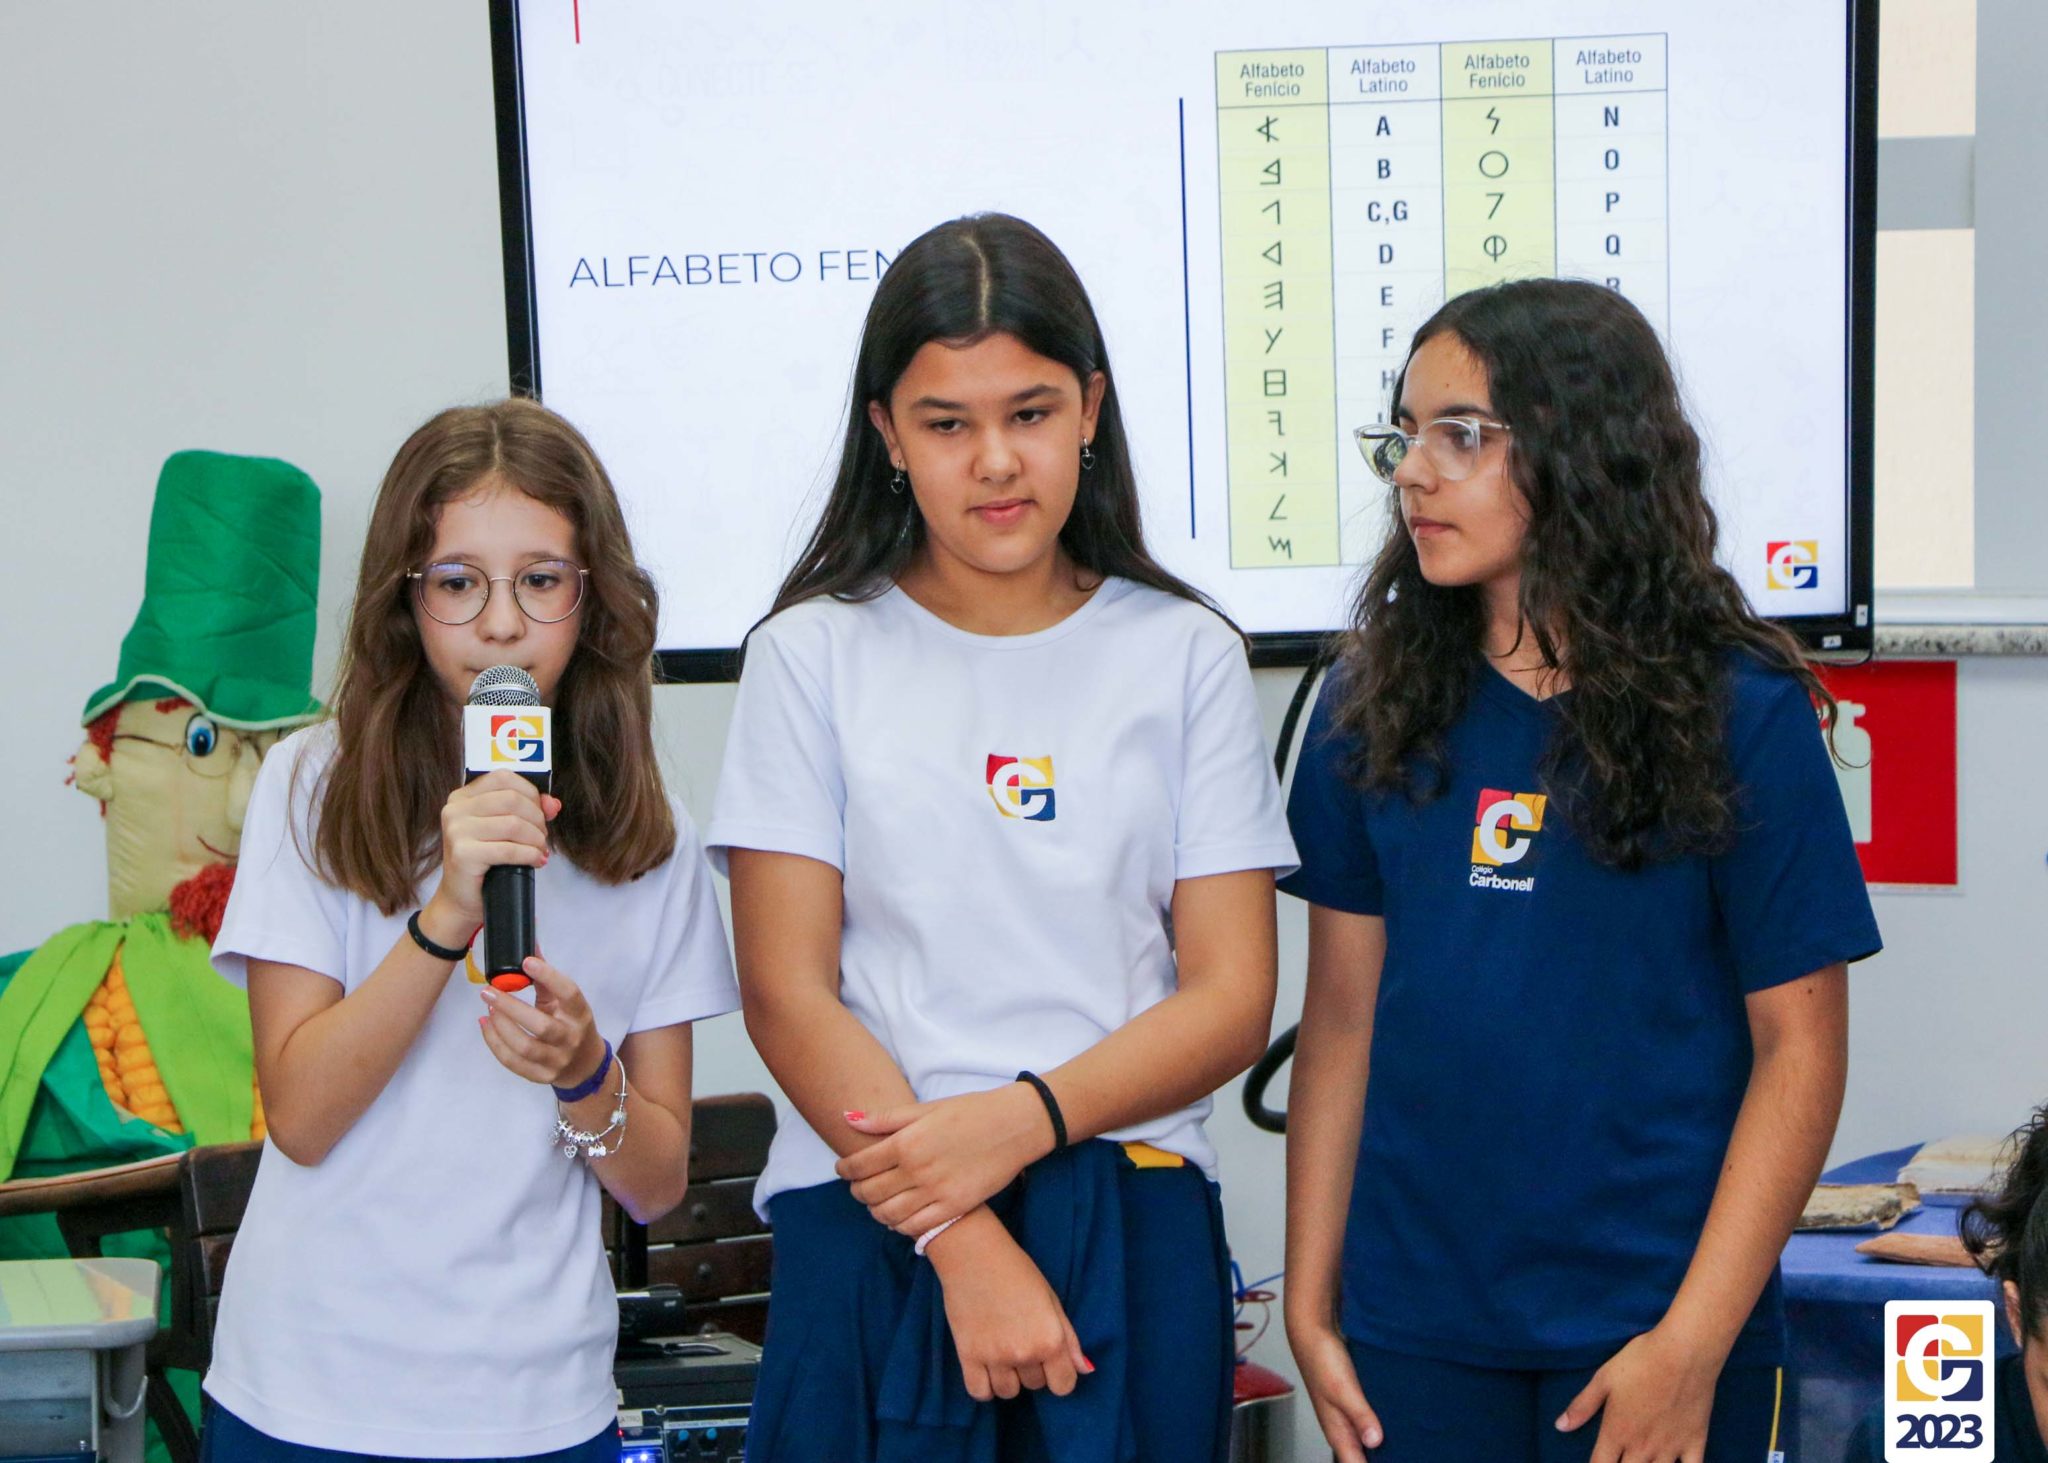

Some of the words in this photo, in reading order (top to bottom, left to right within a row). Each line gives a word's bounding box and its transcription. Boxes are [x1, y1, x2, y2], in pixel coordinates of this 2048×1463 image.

[1351, 58, 1416, 75] Alfabeto
[1464, 54, 1530, 70] Alfabeto
[1576, 49, 1642, 66] Alfabeto
[1240, 63, 1305, 79] Alfabeto
[1584, 69, 1634, 85] Latino
[1359, 78, 1408, 94] Latino
[1375, 115, 1391, 137] A
[1604, 106, 1619, 128] N
[1377, 158, 1391, 180] B
[1604, 148, 1620, 170] O
[1367, 200, 1408, 224] C,G
[1605, 192, 1620, 213] P
[1379, 244, 1394, 265] D
[1605, 234, 1621, 256] Q
[569, 252, 802, 288] ALFABETO
[1380, 286, 1393, 307] E
[1382, 328, 1394, 348] F
[1469, 872, 1535, 892] Carbonell
